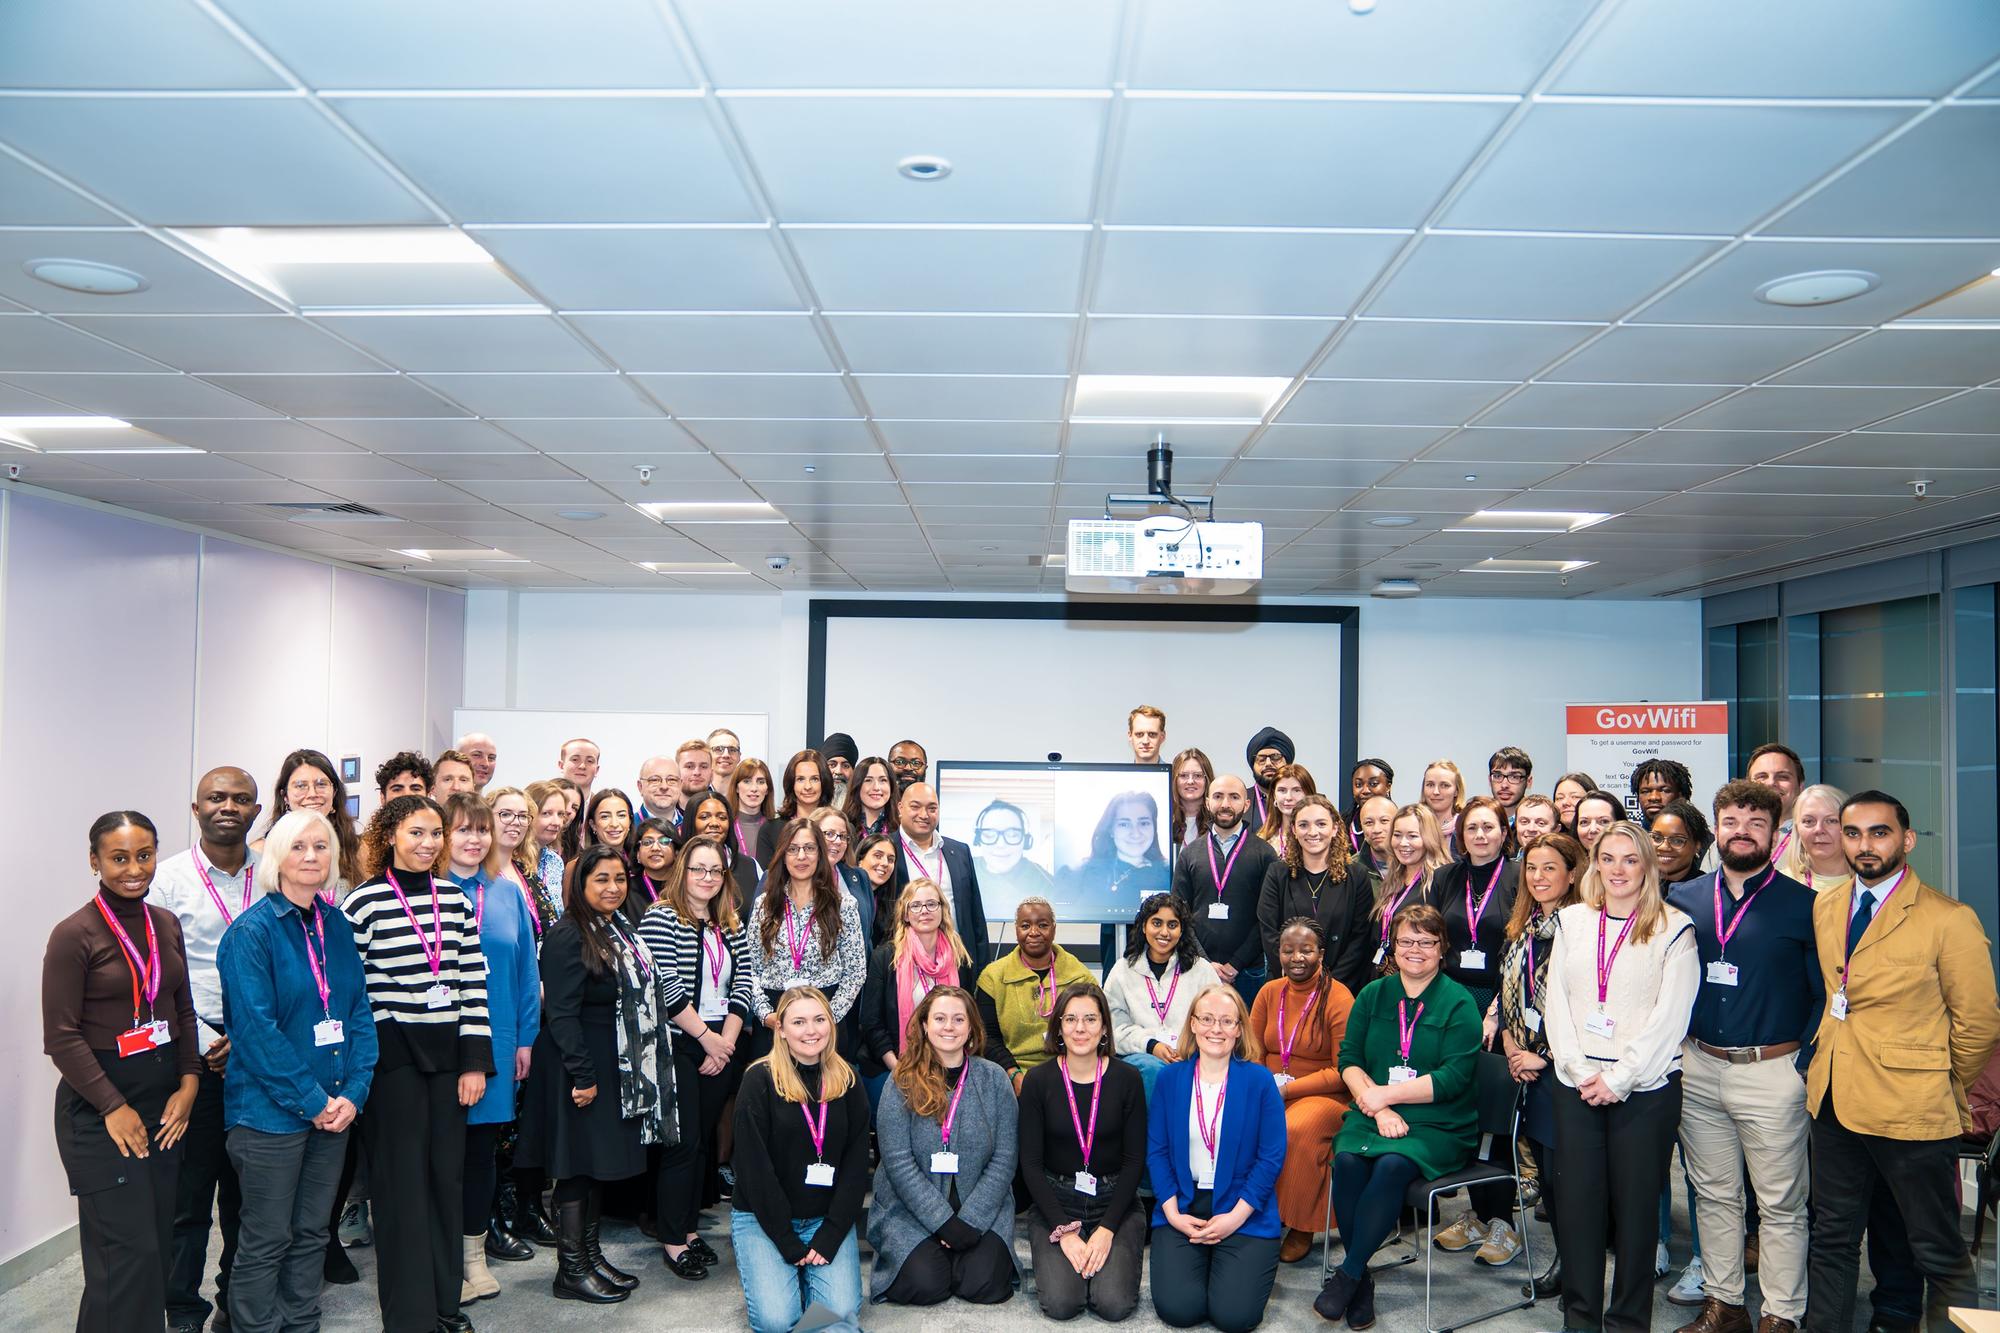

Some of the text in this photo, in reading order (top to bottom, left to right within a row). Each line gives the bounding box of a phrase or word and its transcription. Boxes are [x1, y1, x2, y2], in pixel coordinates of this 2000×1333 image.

[1596, 708, 1697, 729] GovWifi
[1599, 739, 1609, 747] get
[1661, 739, 1692, 747] password
